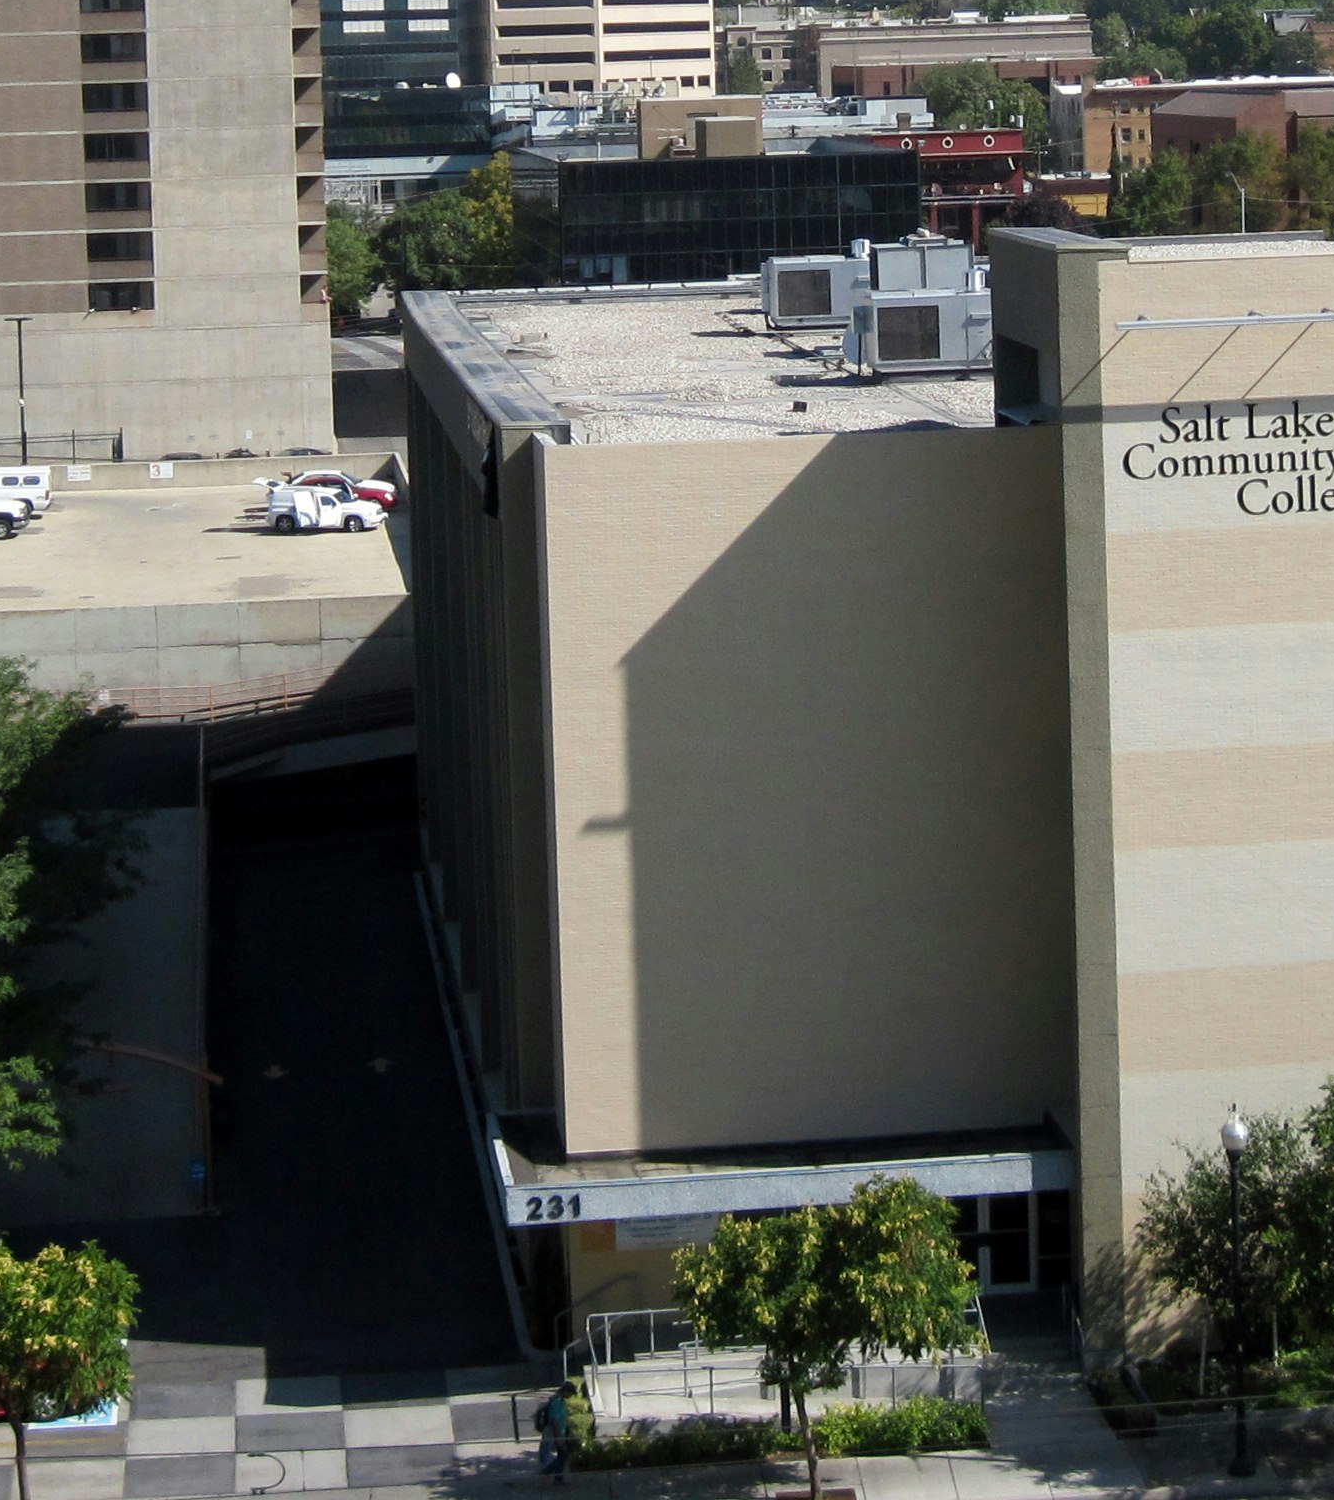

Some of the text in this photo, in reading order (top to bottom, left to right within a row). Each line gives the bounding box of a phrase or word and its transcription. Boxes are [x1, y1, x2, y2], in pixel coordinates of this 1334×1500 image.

[1158, 400, 1334, 444] Salt Lake
[526, 1193, 581, 1222] 231
